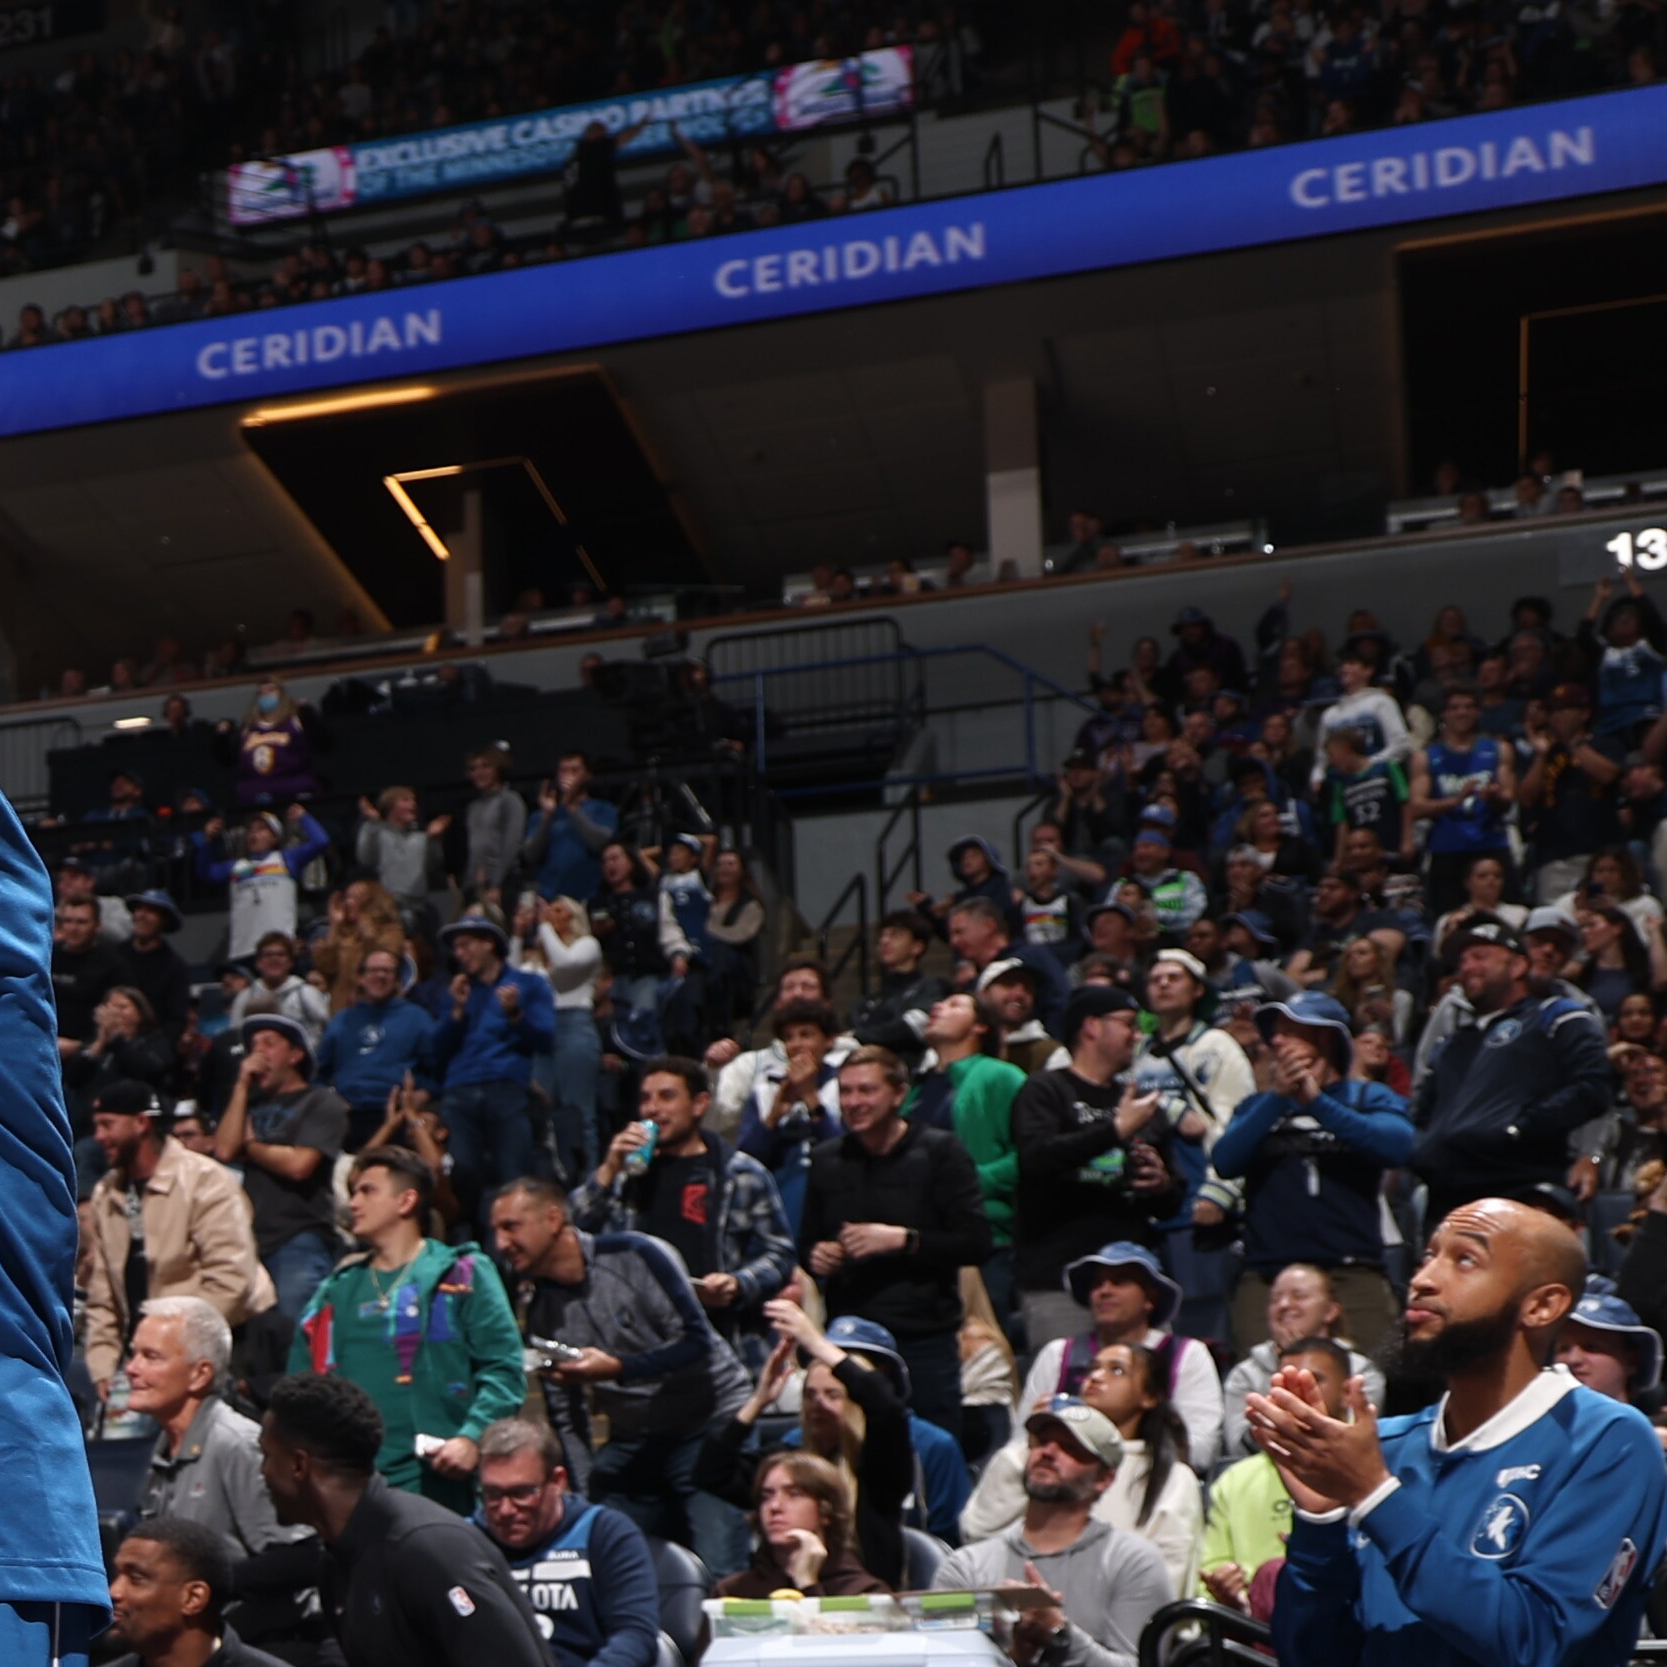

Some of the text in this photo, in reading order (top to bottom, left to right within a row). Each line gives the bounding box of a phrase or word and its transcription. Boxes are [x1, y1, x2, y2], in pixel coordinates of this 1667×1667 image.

[355, 125, 508, 172] EXCLUSIVE
[1290, 126, 1595, 209] CERIDIAN
[714, 223, 986, 299] CERIDIAN
[197, 309, 442, 382] CERIDIAN
